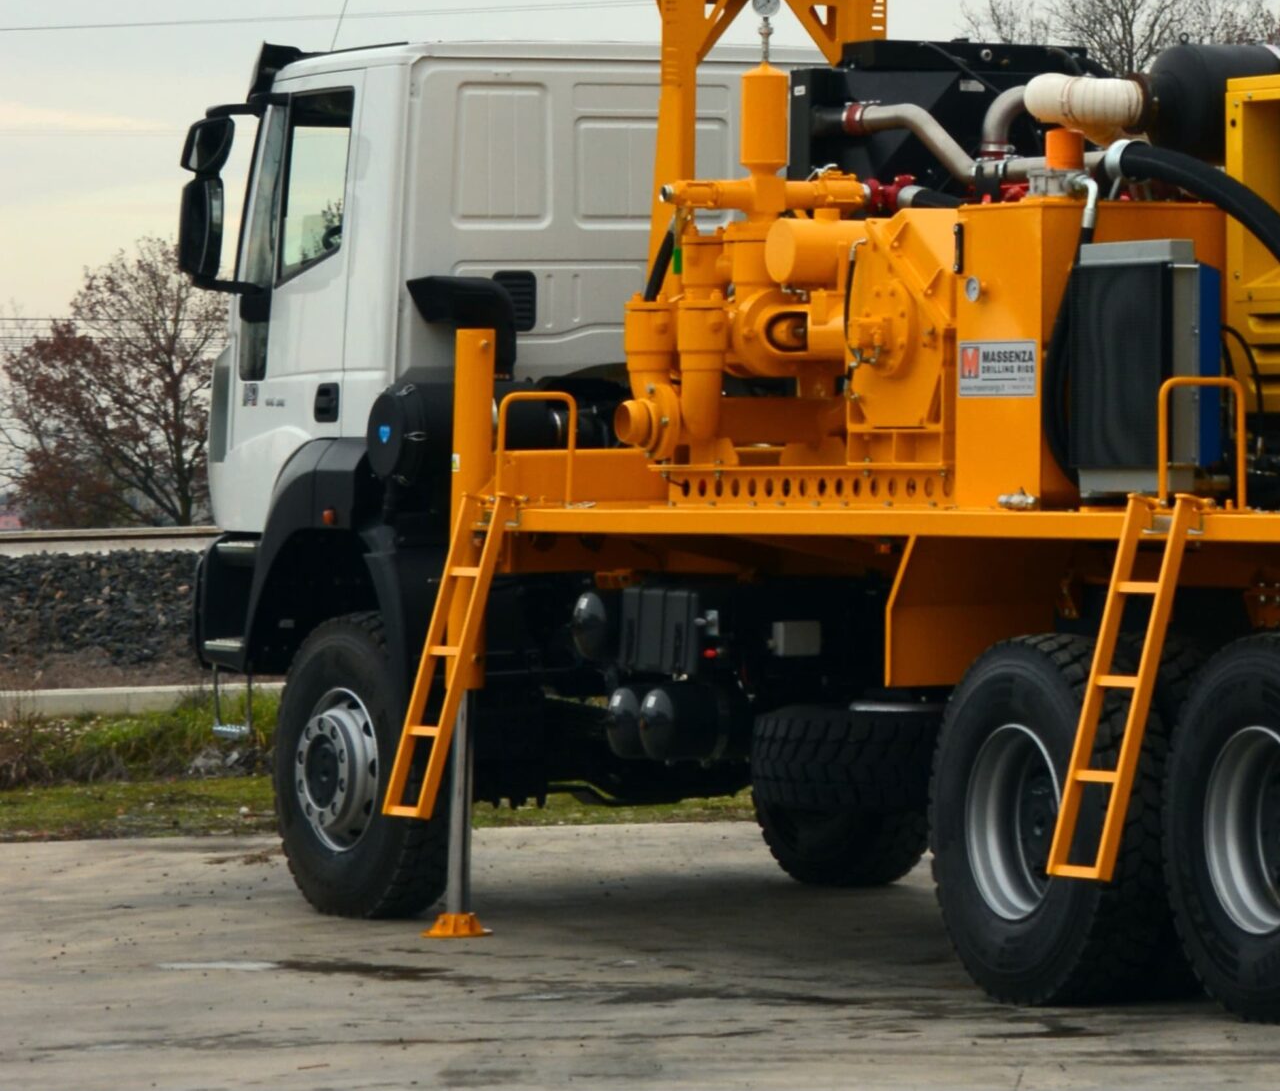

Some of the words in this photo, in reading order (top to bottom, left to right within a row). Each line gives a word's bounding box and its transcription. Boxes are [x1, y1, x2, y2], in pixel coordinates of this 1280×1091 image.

[961, 347, 979, 378] M
[982, 350, 1034, 363] MASSENZA
[982, 365, 1014, 374] DRILLING
[1017, 364, 1034, 373] RIGS
